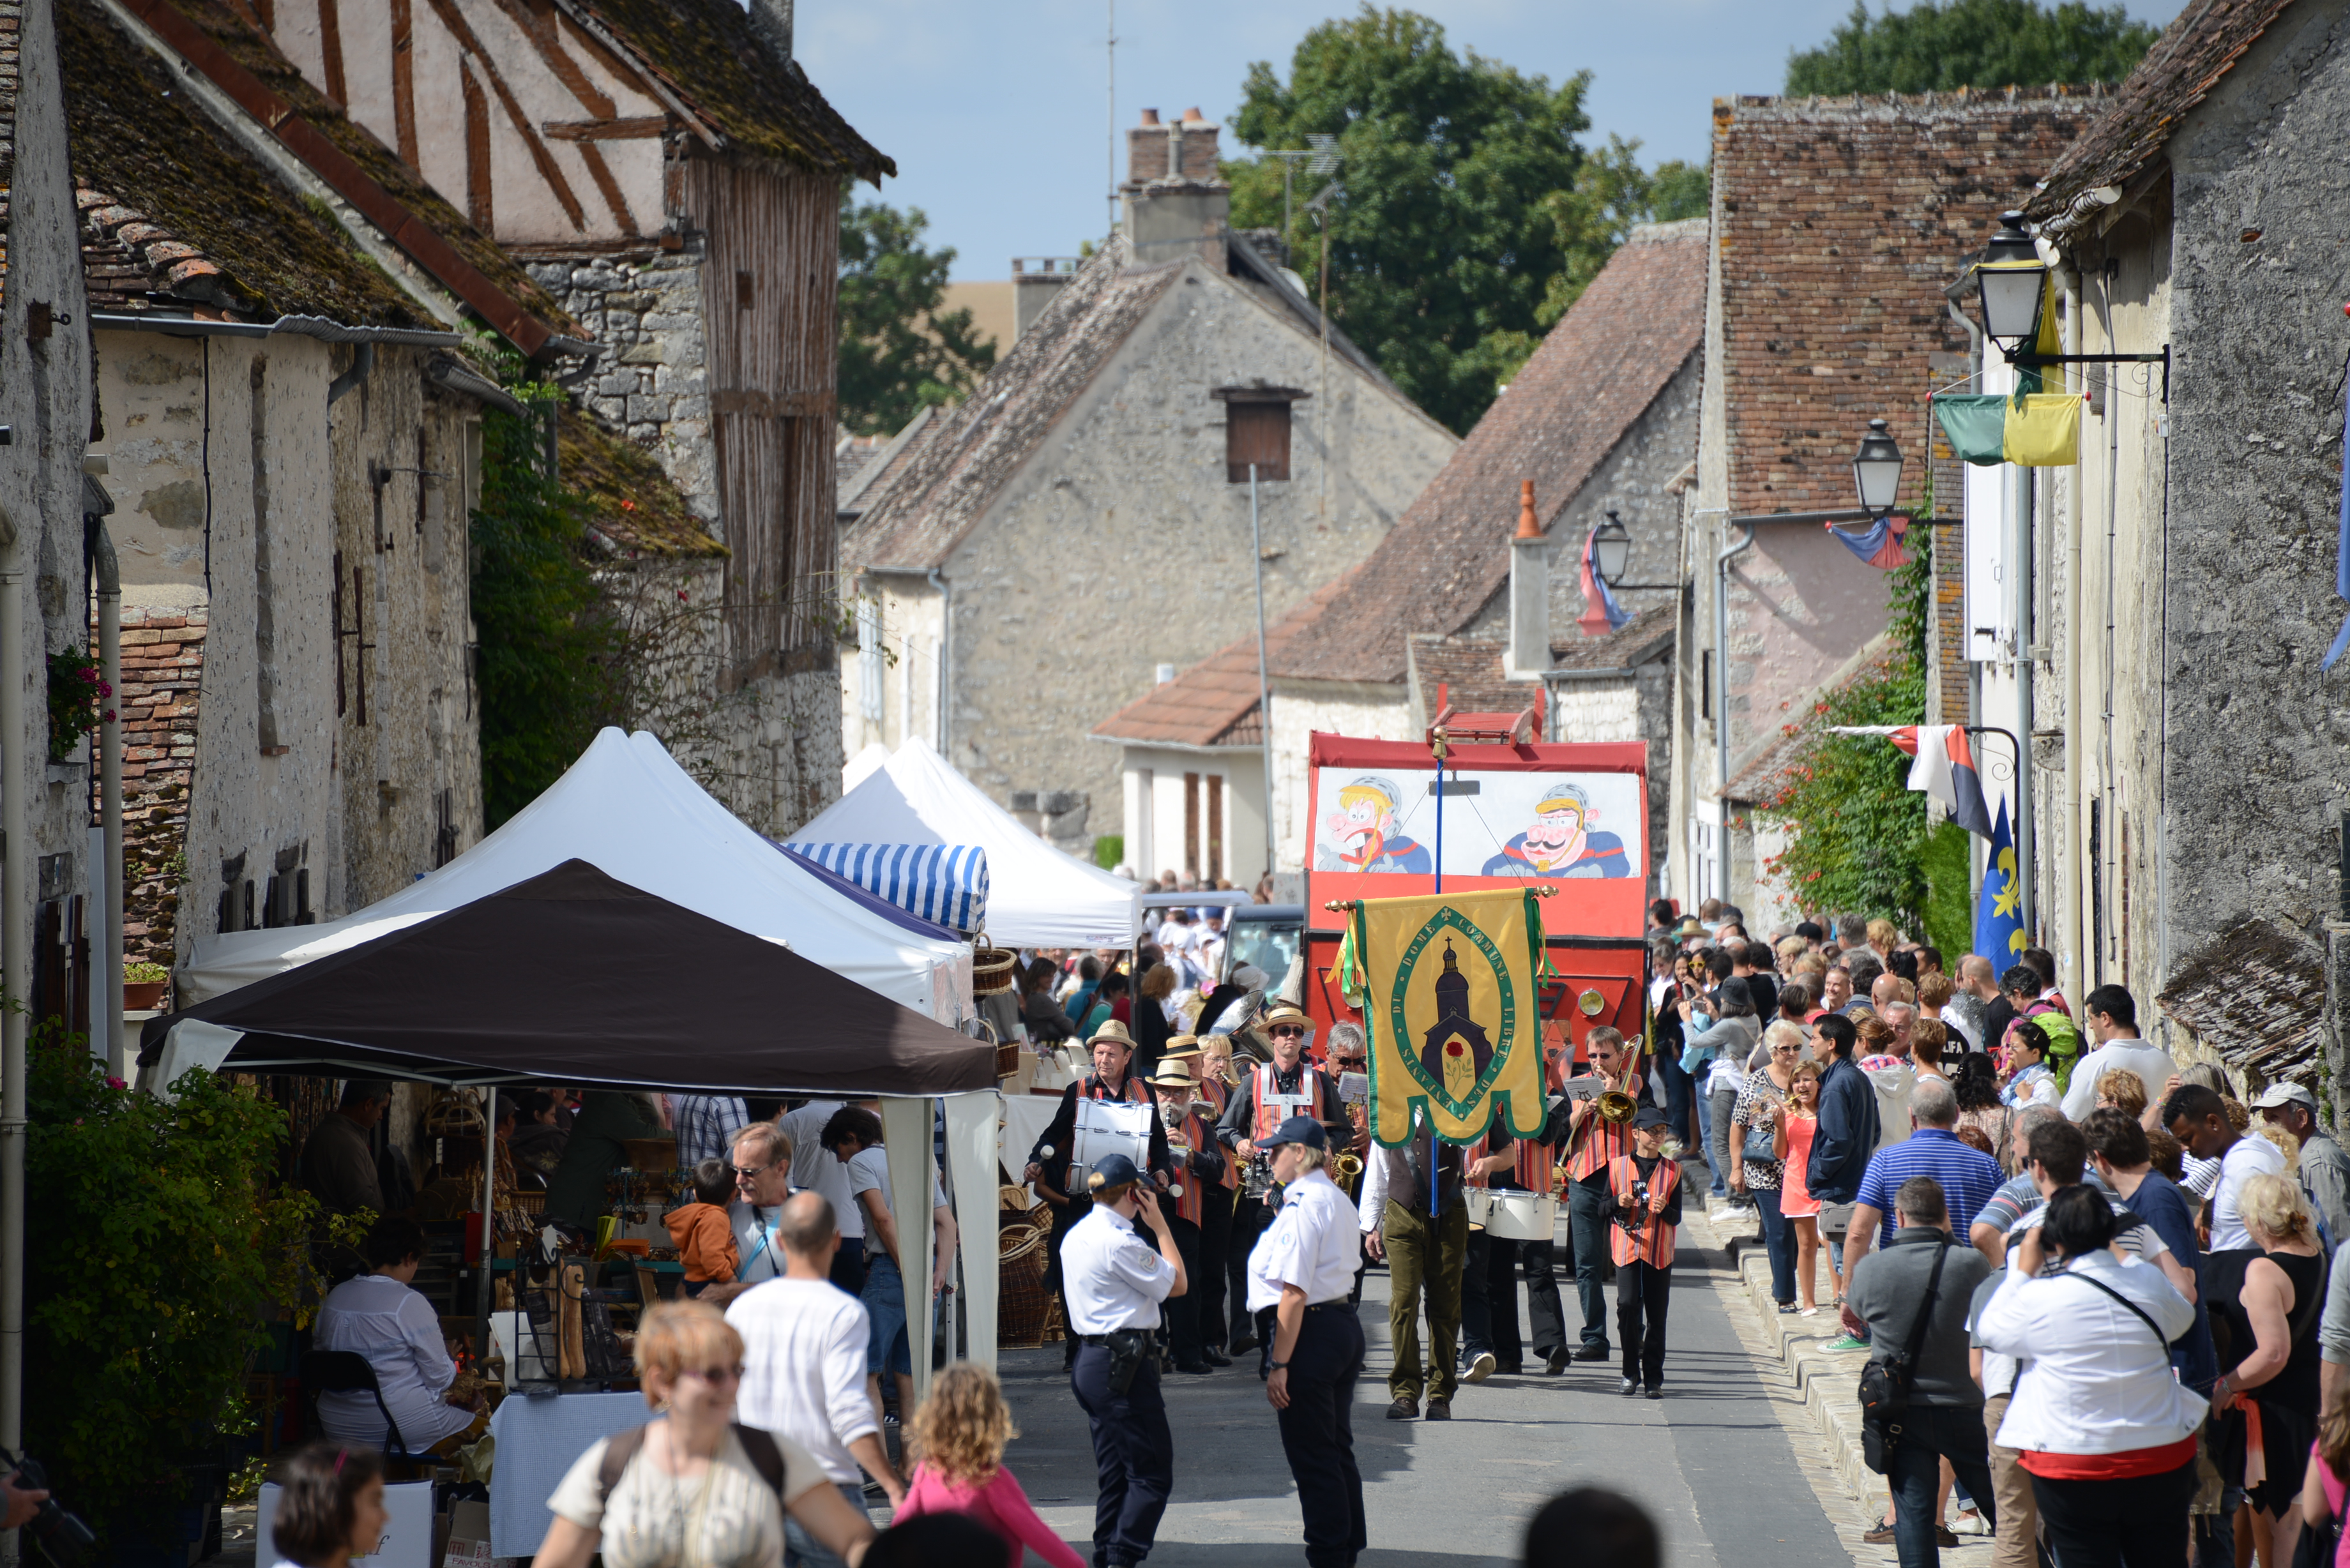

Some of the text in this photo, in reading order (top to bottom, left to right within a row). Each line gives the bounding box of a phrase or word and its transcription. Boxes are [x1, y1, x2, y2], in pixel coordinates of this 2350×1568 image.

[1538, 862, 1548, 870] SP
[1392, 918, 1514, 1108] COMMUNE LIBRE DES ENFANTS DU DOME
[452, 1557, 491, 1568] FAVOLS
